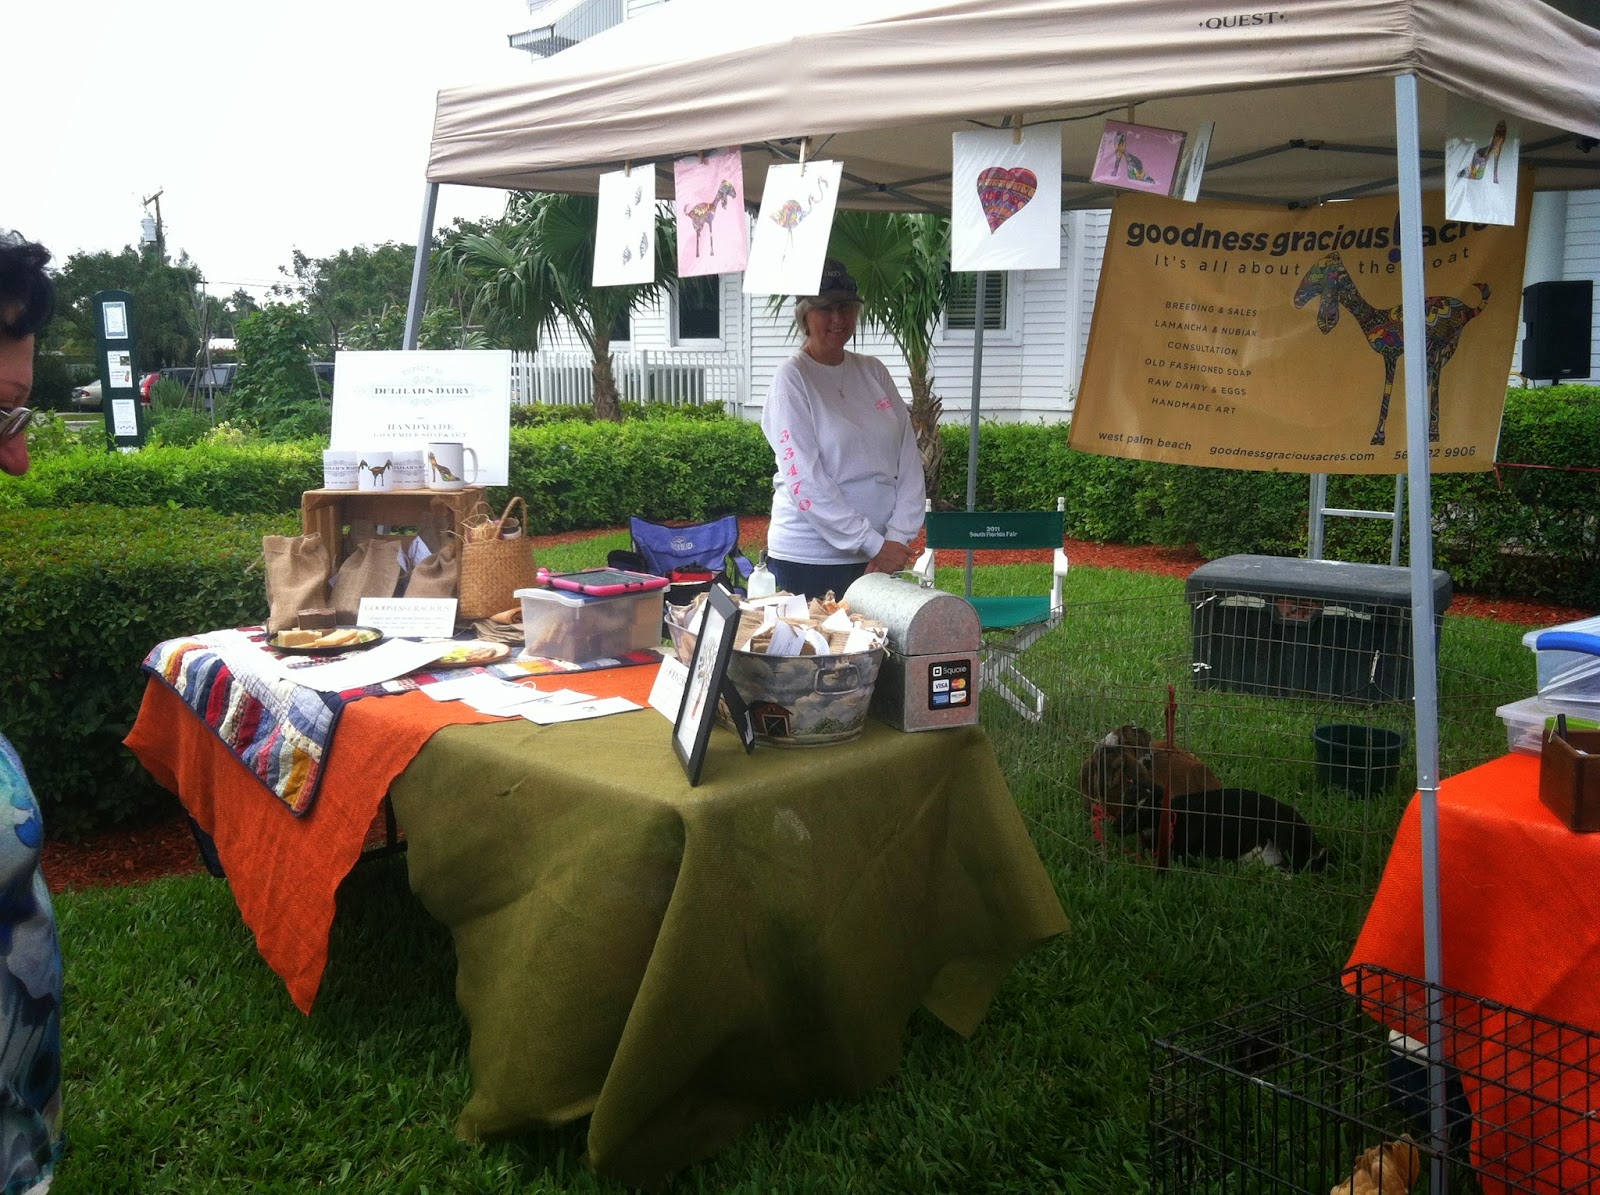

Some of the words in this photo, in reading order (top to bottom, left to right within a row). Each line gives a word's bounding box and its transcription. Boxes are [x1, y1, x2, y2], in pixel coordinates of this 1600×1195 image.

[1205, 11, 1279, 29] QUEST
[1126, 221, 1269, 251] goodness
[1154, 254, 1186, 269] It's
[1199, 260, 1228, 274] all
[1238, 261, 1301, 275] about
[1358, 261, 1395, 274] the
[1424, 246, 1469, 269] oat
[1165, 301, 1215, 313] BREEDING
[1217, 306, 1224, 314] &
[1227, 307, 1258, 317] SALES
[1154, 320, 1208, 333] LAMANCHA
[1211, 326, 1218, 334] &
[1221, 327, 1258, 337] NUBIAN
[1167, 341, 1239, 356] CONSULTATION
[1144, 358, 1166, 368] OLD
[1169, 361, 1224, 375] FASHIONED
[1226, 368, 1252, 377] SOAP
[1147, 377, 1172, 388] RAW
[1175, 381, 1208, 392] DAIRY
[1211, 386, 1218, 394] &
[1221, 387, 1247, 396] EGGS
[1151, 397, 1212, 412] HANDMADE
[1215, 406, 1237, 415] ART
[1098, 432, 1125, 442] west
[1126, 435, 1154, 446] palm
[1156, 438, 1192, 450] beach
[1209, 446, 1375, 462] goodnessgraciousacres.com
[1393, 450, 1408, 460] 56
[1443, 445, 1476, 458] 9906
[943, 666, 966, 675] Square
